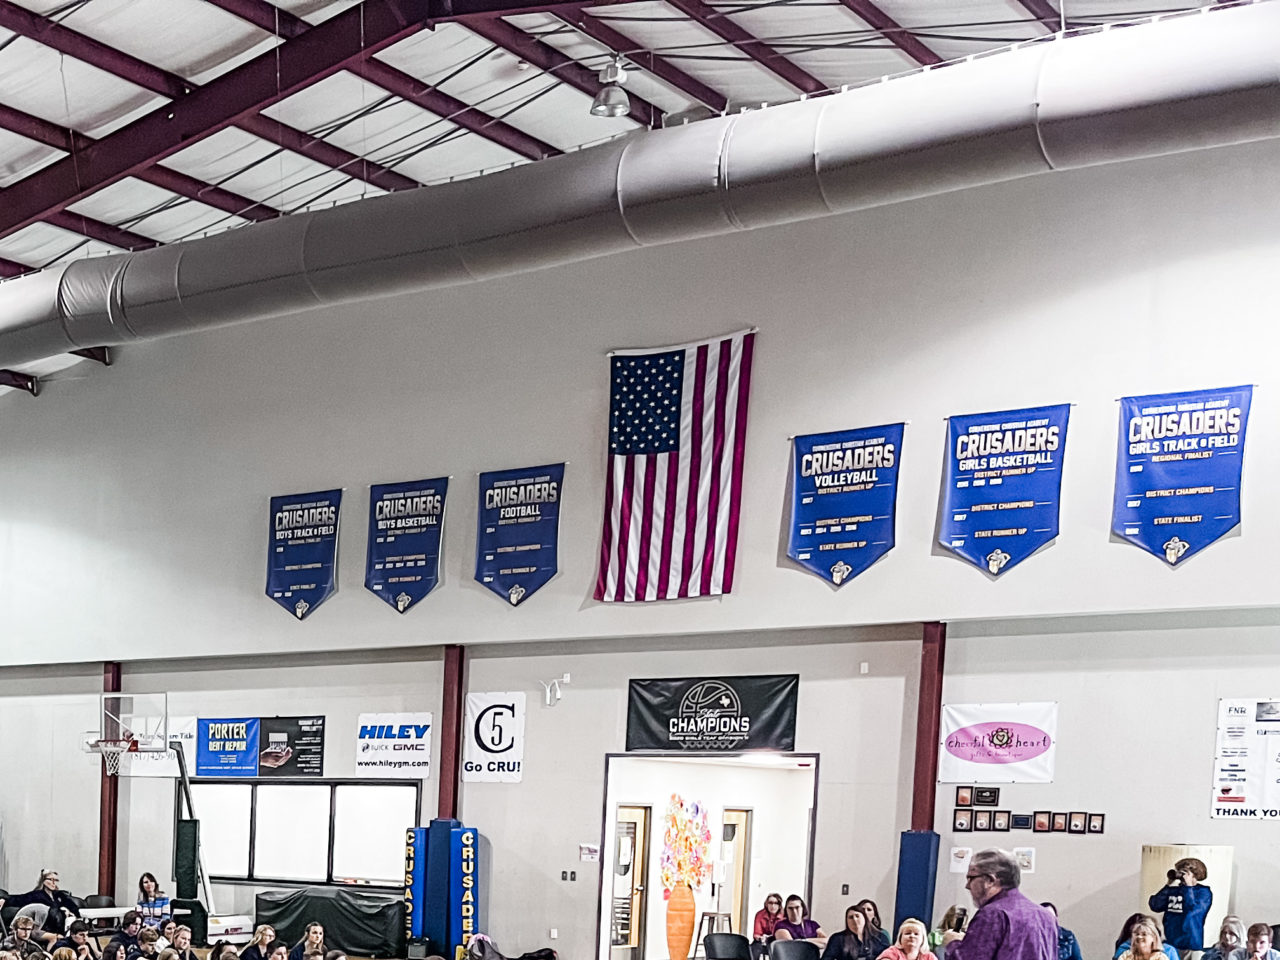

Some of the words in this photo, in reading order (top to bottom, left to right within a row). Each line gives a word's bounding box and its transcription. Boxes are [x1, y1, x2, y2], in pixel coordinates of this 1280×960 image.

[1129, 407, 1241, 442] CRUSADERS
[956, 426, 1060, 460] CRUSADERS
[1129, 441, 1160, 455] GIRLS
[1163, 438, 1198, 452] TRACK
[1208, 434, 1238, 448] FIELD
[801, 444, 894, 477] CRUSADERS
[959, 458, 987, 471] GIRLS
[989, 452, 1053, 469] BASKETBALL
[815, 469, 878, 487] VOLLEYBALL
[485, 482, 557, 509] CRUSADERS
[375, 495, 441, 520] CRUSADERS
[500, 505, 540, 518] FOOTBALL
[275, 506, 335, 530] CRUSADERS
[378, 519, 395, 529] BOYS
[397, 516, 437, 528] BASKETBALL
[276, 530, 292, 540] BOYS
[293, 528, 313, 539] TRACK
[318, 526, 334, 536] FIELD
[209, 723, 247, 739] PORTER
[358, 725, 430, 739] HILEY
[669, 717, 750, 732] CHAMPIONS
[209, 740, 224, 752] DENT
[225, 740, 247, 752] REPAIR
[393, 743, 425, 751] GMC
[1015, 734, 1047, 748] heart
[357, 760, 429, 768] www.hileygm.com
[465, 761, 482, 772] Go
[487, 761, 521, 772] CRU!
[1215, 808, 1257, 817] THANK
[1262, 809, 1280, 817] YO
